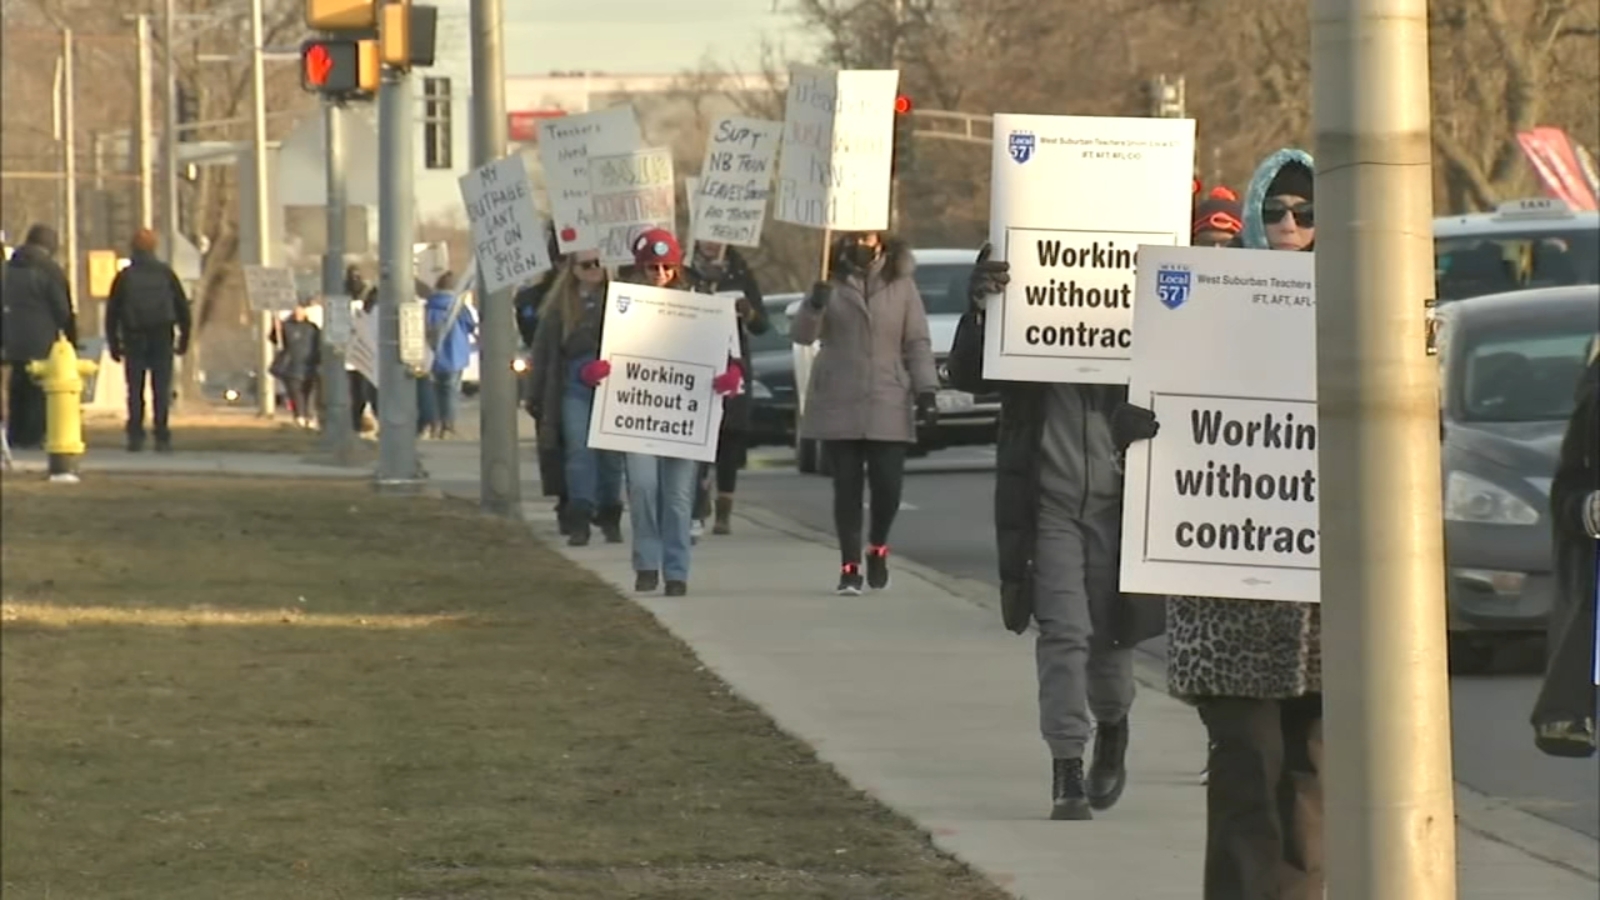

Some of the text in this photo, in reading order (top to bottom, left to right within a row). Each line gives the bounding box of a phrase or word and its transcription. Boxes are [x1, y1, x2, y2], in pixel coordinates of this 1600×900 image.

[1010, 146, 1034, 158] 571
[1011, 136, 1034, 145] Local
[710, 152, 734, 172] NB
[479, 165, 499, 187] MY
[478, 224, 523, 261] FIT ON
[1160, 273, 1188, 284] Local
[1197, 274, 1311, 290] West Suburban Teachers
[1025, 278, 1131, 309] without
[1159, 285, 1188, 301] 571
[626, 361, 695, 391] Working
[617, 387, 698, 413] without a
[614, 413, 694, 437] contract!
[1174, 460, 1316, 503] without
[1174, 517, 1321, 555] contrac
